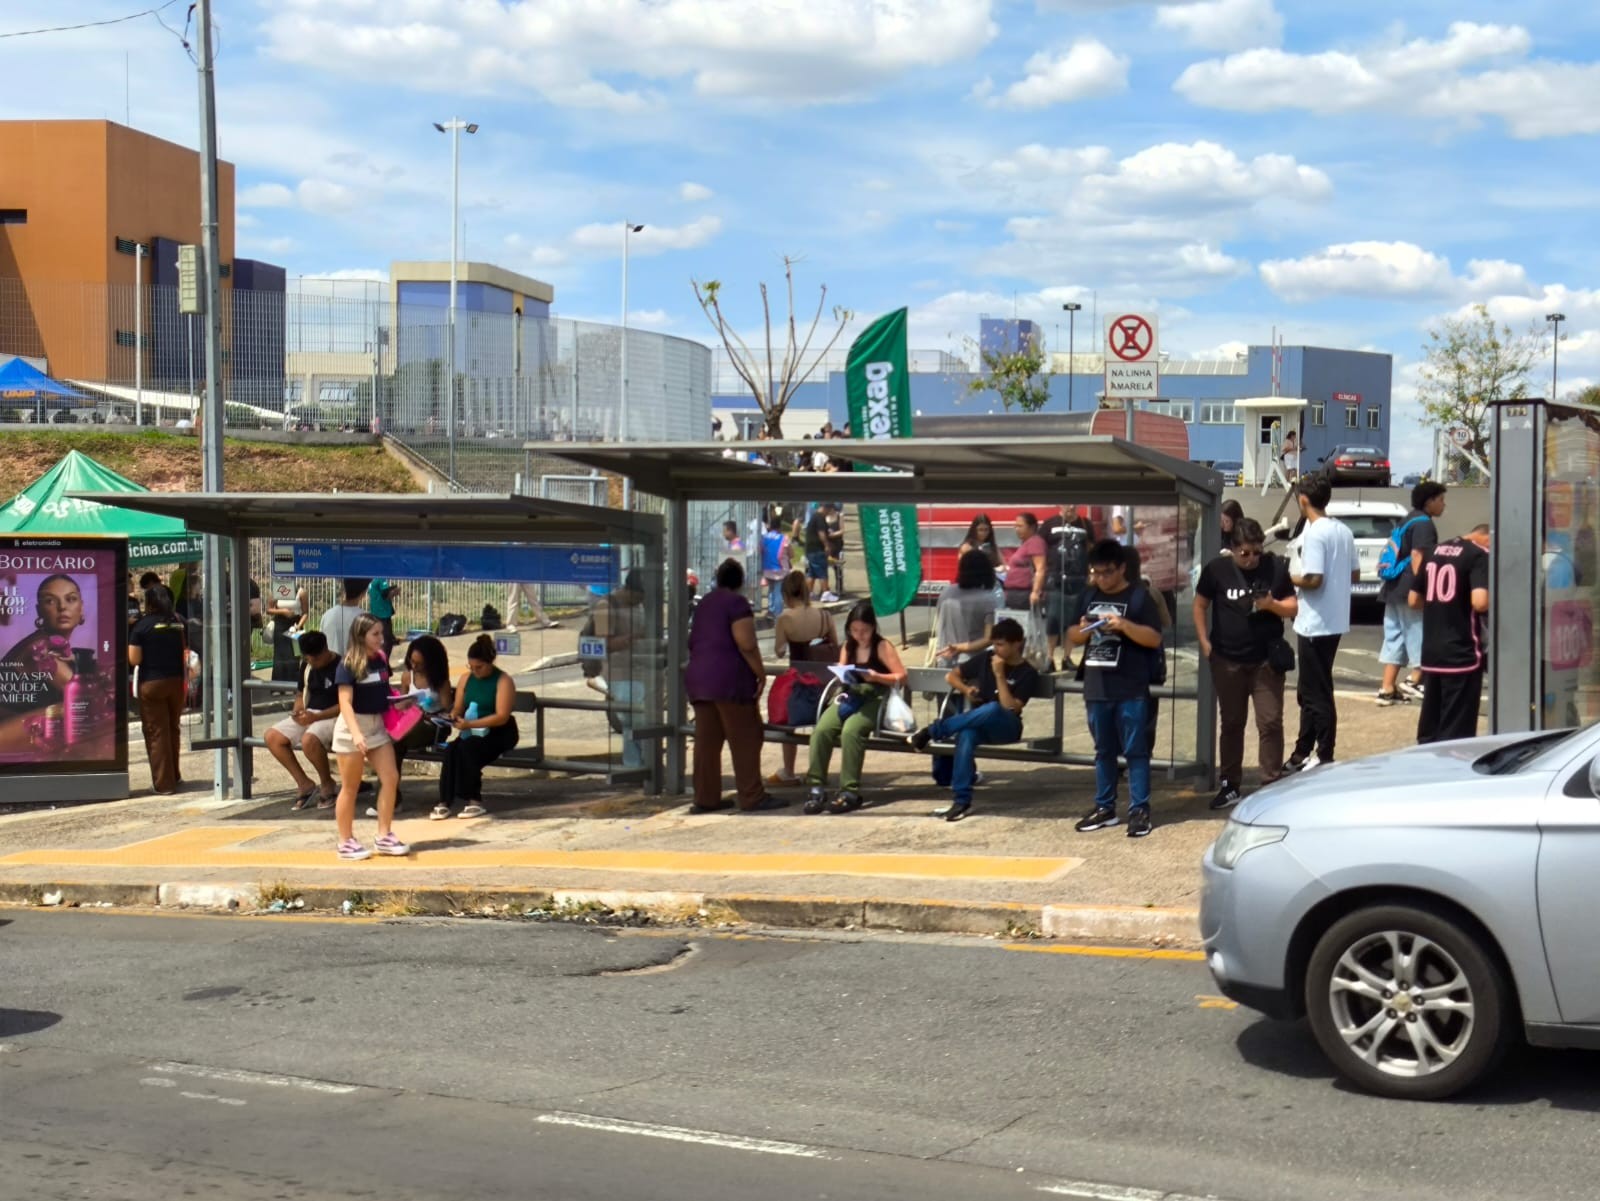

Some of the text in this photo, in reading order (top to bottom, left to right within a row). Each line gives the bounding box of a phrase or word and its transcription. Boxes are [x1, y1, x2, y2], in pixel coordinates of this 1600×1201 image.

[1110, 381, 1153, 391] AMARELA
[1111, 369, 1152, 377] NA LINHA
[878, 508, 895, 577] TRADIÇÃO EM
[890, 511, 907, 572] APROVAÇÃO
[1425, 561, 1457, 603] 10
[31, 671, 54, 681] SPA
